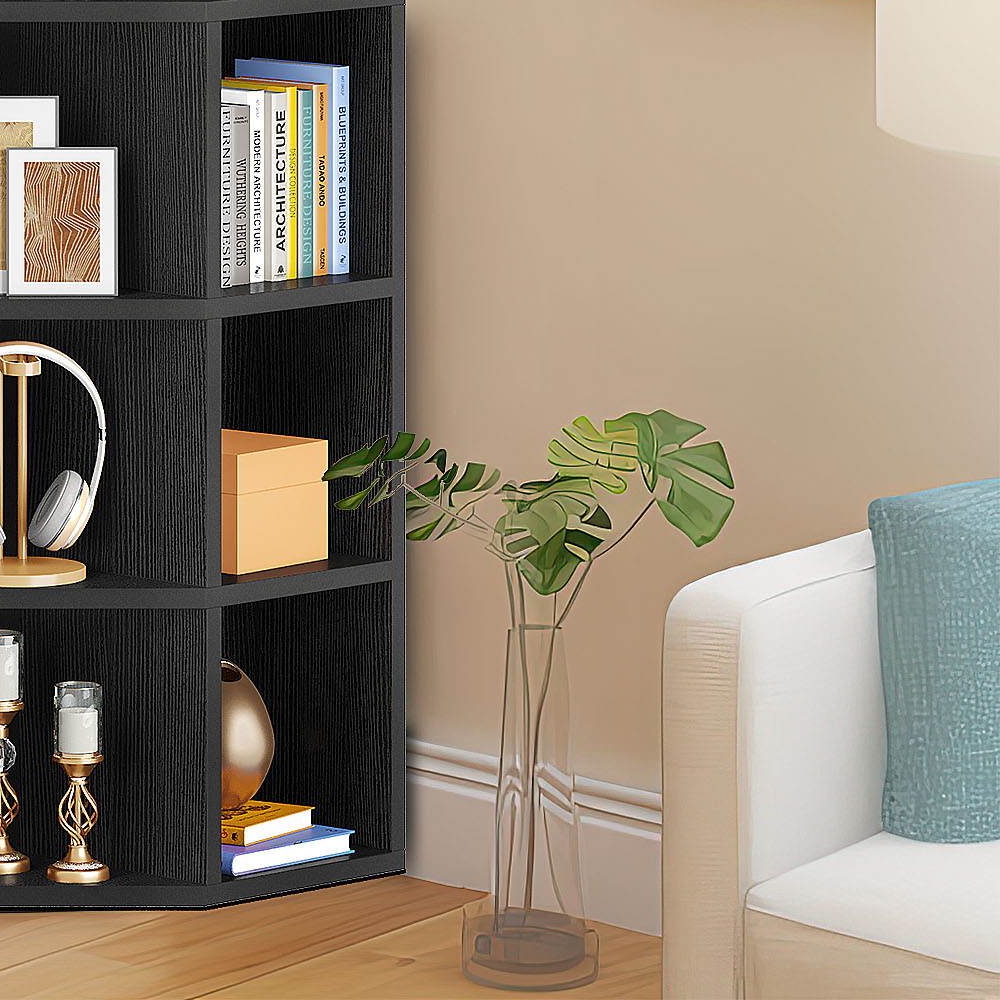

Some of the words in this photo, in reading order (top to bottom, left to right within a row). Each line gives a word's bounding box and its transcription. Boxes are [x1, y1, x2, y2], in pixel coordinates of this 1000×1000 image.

[221, 110, 231, 216] FURNITURE
[253, 130, 261, 173] MODERN
[289, 148, 297, 174] DESIGN
[302, 106, 312, 201] FURNITURE
[318, 155, 326, 182] TADAO
[338, 106, 347, 173] BLUEPRINTS
[235, 158, 247, 220] WUTHERING
[275, 110, 286, 252] ARCHITECTURE
[289, 175, 297, 218] COLLECTION
[318, 183, 326, 207] ANDO
[253, 176, 261, 253] ARCHITECTURE
[302, 204, 312, 264] DESIGN
[338, 186, 347, 244] BUILDINGS
[221, 222, 231, 288] DESIGN
[235, 223, 247, 267] HEIGHTS
